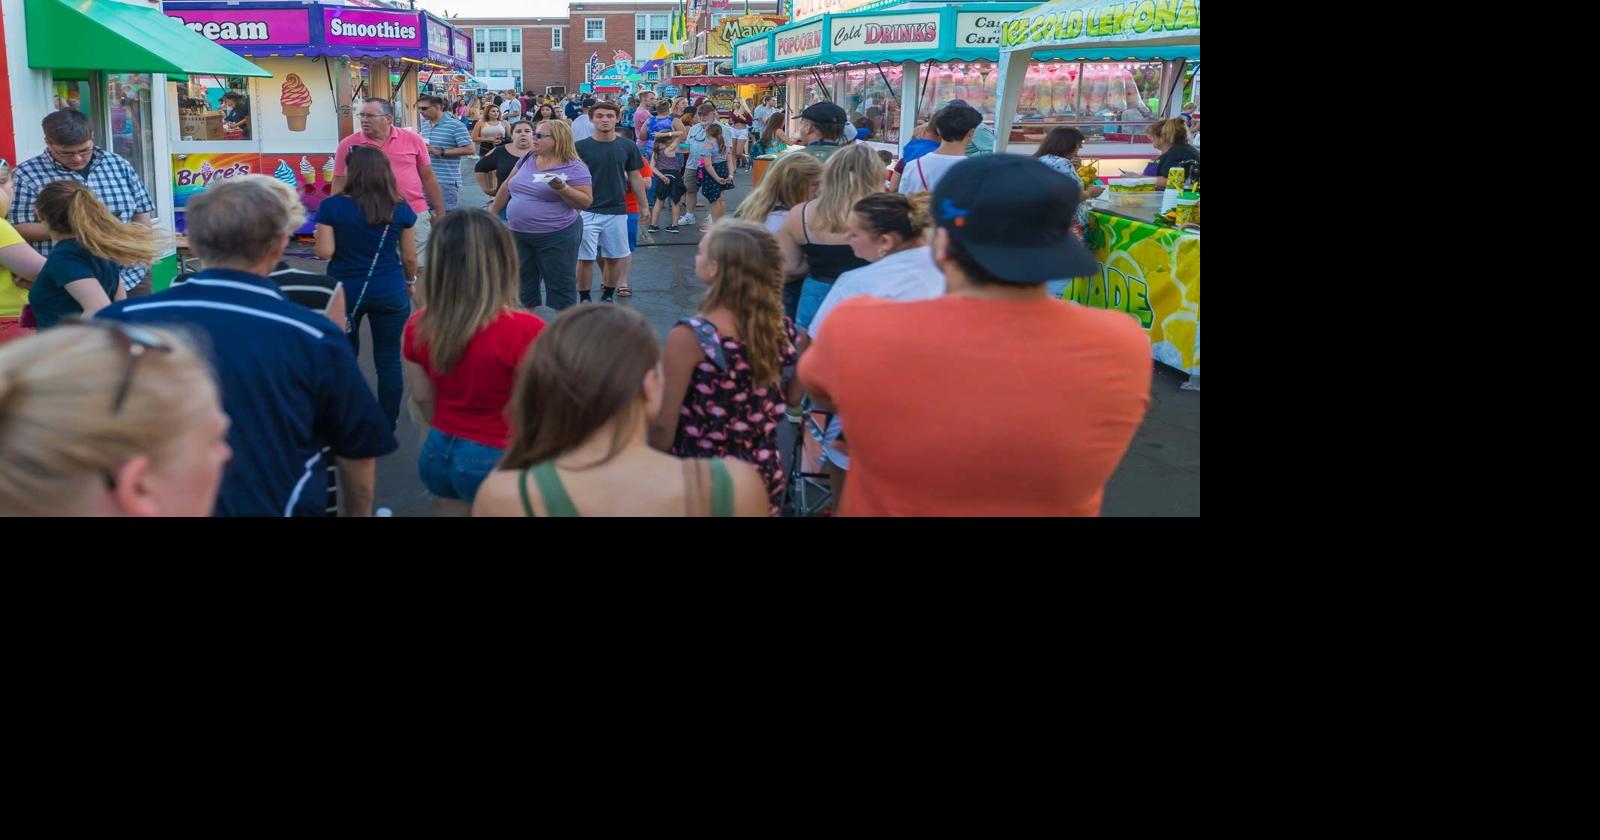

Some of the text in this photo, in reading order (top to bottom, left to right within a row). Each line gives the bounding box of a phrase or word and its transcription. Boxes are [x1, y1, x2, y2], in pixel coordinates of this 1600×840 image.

[169, 15, 269, 40] ream
[330, 18, 416, 39] Smoothies
[833, 22, 936, 46] Cold DRINKS
[1001, 18, 1030, 47] ICE
[1031, 10, 1083, 40] COLD
[777, 30, 822, 56] POPCORN
[177, 162, 249, 187] Bryce's
[1062, 262, 1154, 329] NADE
